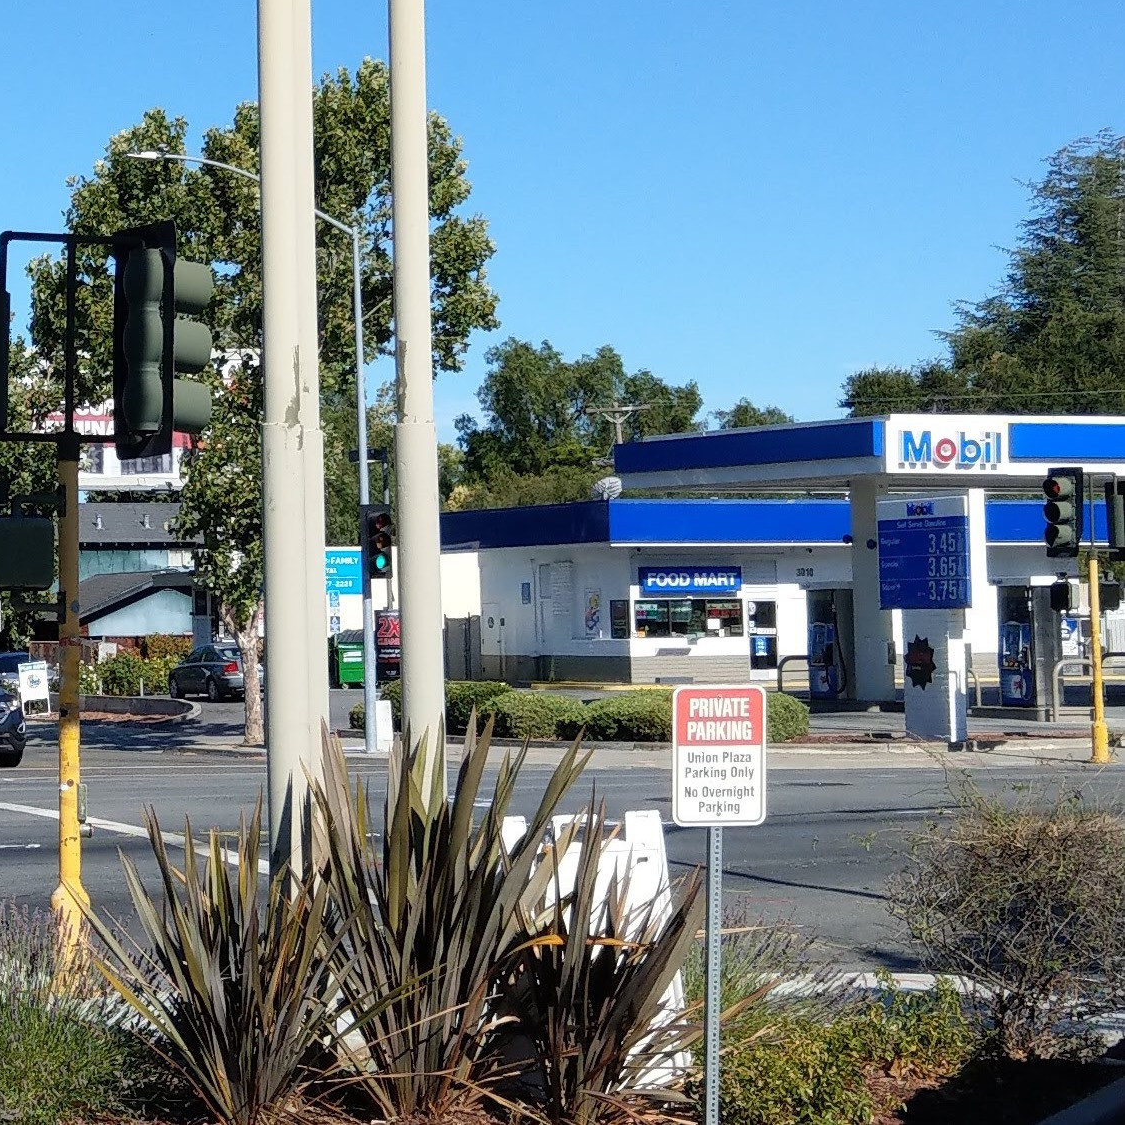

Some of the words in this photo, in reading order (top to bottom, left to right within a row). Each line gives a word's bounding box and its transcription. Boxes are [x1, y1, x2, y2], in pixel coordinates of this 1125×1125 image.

[901, 430, 1002, 464] Mobil
[647, 573, 690, 587] FOOD
[693, 573, 737, 587] MART
[689, 697, 750, 718] PRIVATE
[687, 720, 753, 741] PARKING
[687, 751, 718, 763] Union
[722, 751, 752, 763] Plaza
[685, 766, 727, 780] Parking
[730, 766, 755, 780] Only
[684, 786, 698, 798] No
[702, 785, 755, 800] Overnight
[698, 800, 740, 815] Parking
